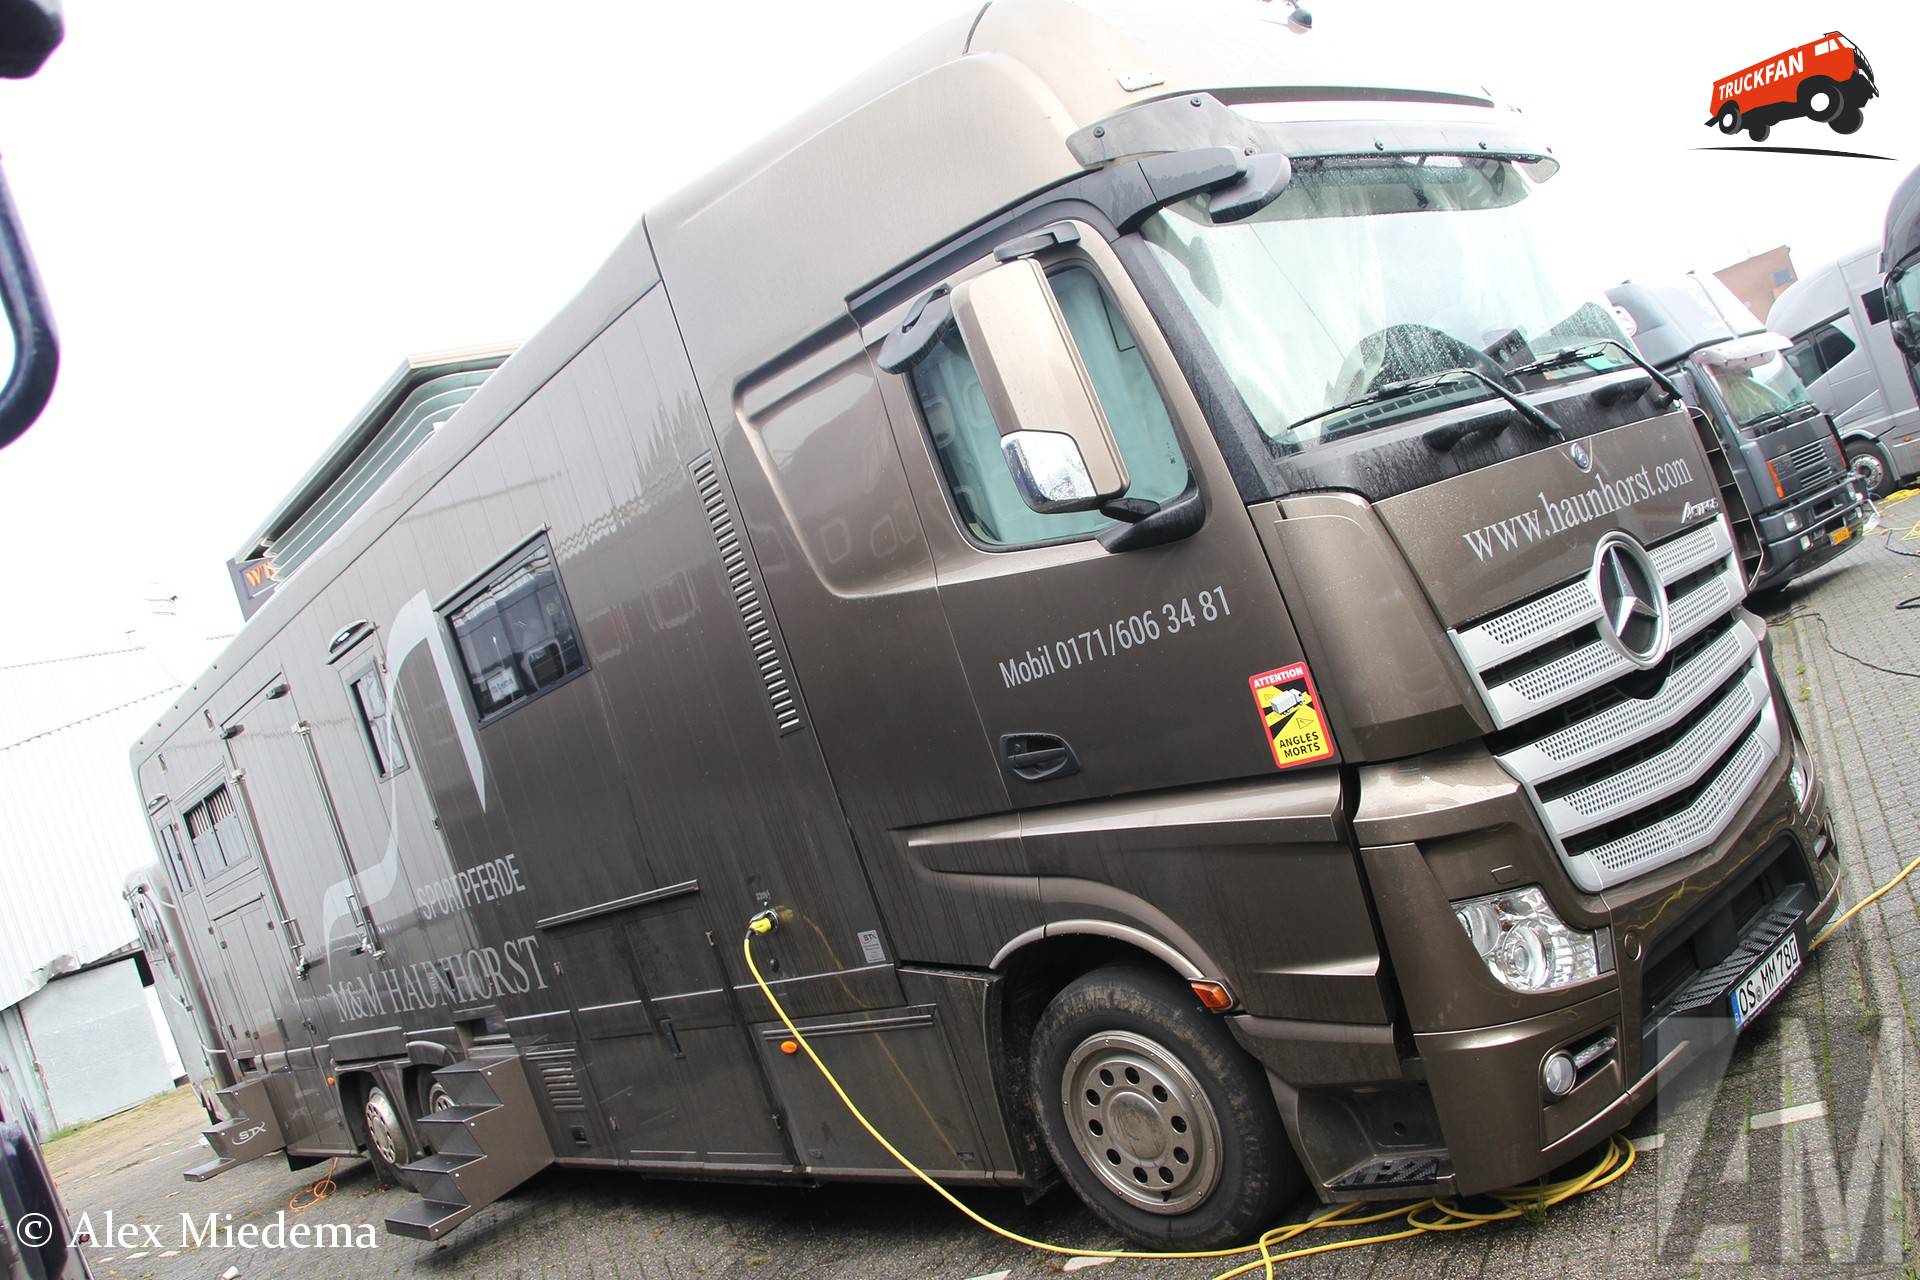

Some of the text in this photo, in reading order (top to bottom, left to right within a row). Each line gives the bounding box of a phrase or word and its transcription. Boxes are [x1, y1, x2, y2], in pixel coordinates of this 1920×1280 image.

[1462, 455, 1694, 563] www.haunhorst.com
[999, 585, 1231, 689] Mobil 0171/606 34 81
[1253, 666, 1305, 689] ATTENTION
[1279, 731, 1320, 749] ANGLES
[1283, 741, 1321, 759] MORTS
[416, 853, 526, 921] SPORTPFERDE
[328, 935, 549, 1024] M&M HAUNHORST
[1738, 979, 1757, 1016] OS
[1760, 957, 1779, 995] MM
